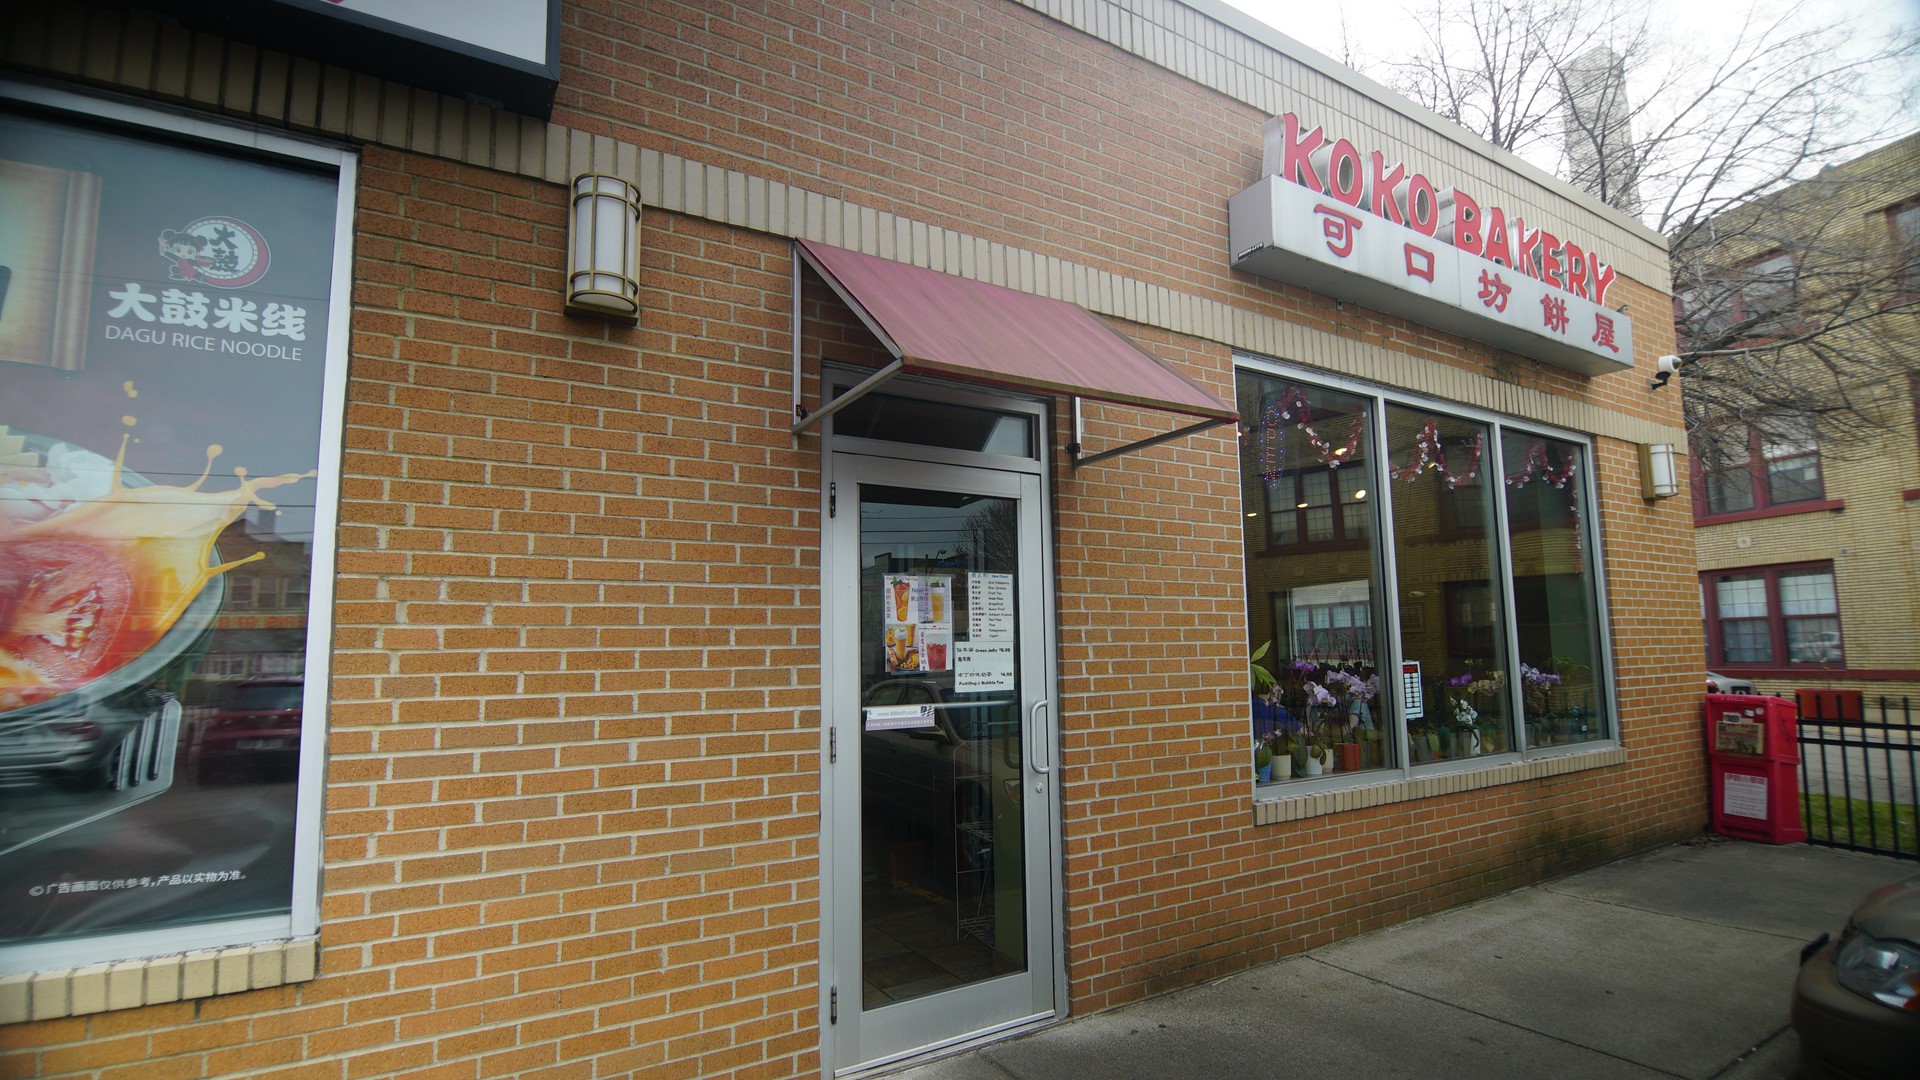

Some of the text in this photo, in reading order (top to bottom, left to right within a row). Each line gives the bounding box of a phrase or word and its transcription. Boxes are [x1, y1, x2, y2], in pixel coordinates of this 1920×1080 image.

[1281, 111, 1617, 307] KOKO BAKERY
[106, 282, 307, 342] 大鼓米线
[104, 325, 303, 362] DAGU RICE NOODLE
